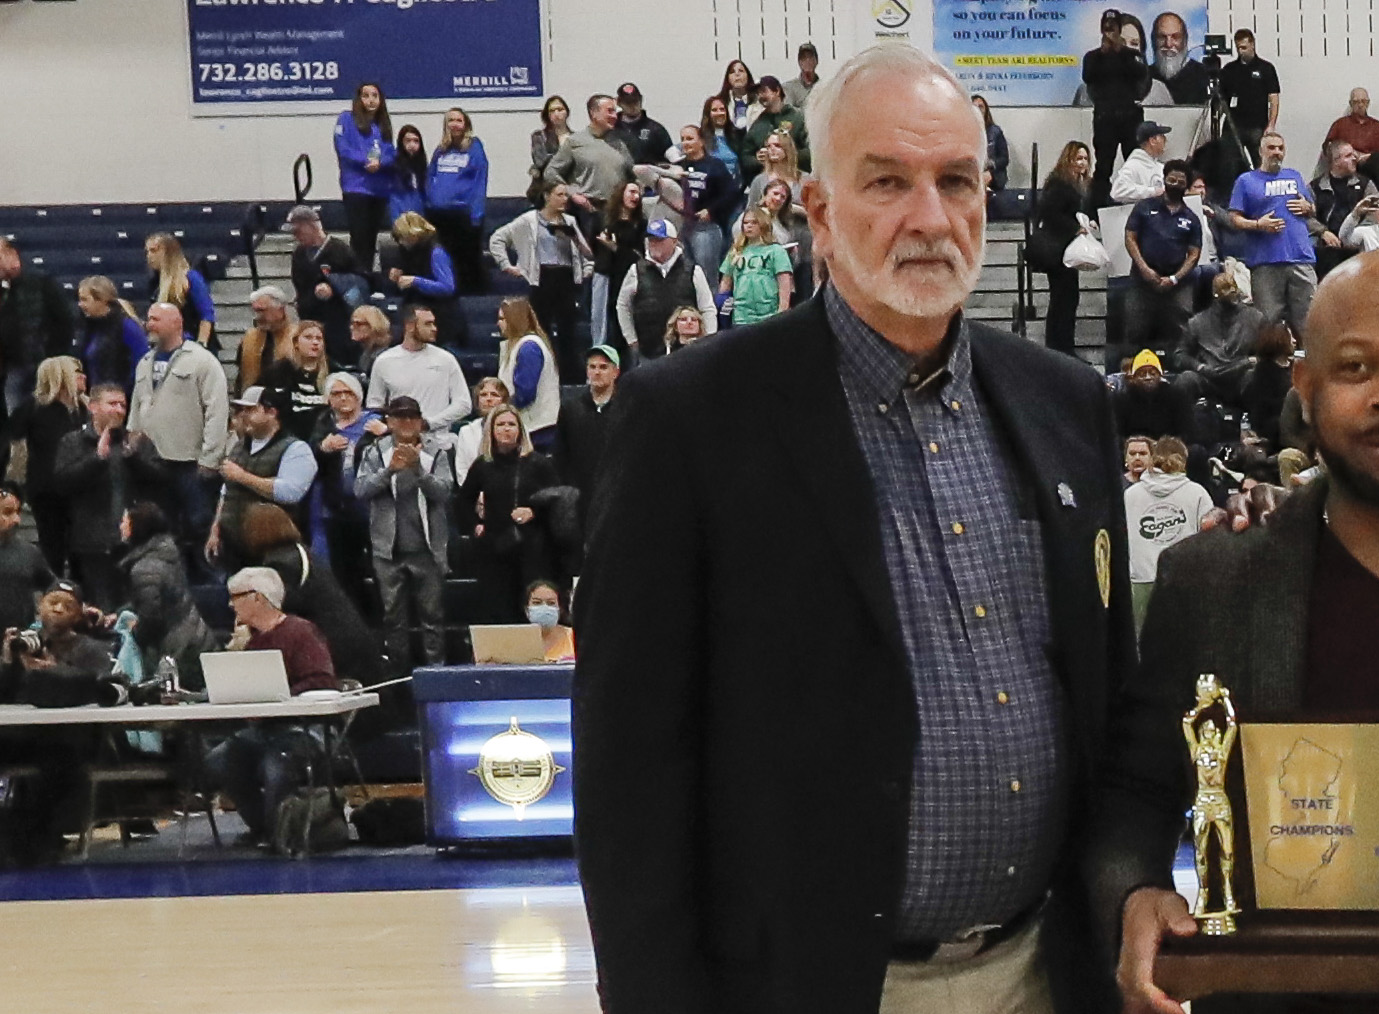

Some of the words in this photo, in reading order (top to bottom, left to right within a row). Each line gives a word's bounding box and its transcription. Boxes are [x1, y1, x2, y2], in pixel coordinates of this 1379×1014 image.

[952, 11, 968, 20] so
[971, 11, 997, 24] you
[999, 11, 1025, 20] can
[1028, 7, 1066, 20] focus
[952, 29, 972, 39] on
[973, 29, 1008, 43] your
[1010, 26, 1062, 40] future.
[198, 61, 339, 82] 732.286.3128
[453, 76, 508, 86] MERRILL
[1264, 180, 1298, 197] NIKE
[1291, 798, 1334, 810] STATE
[1269, 825, 1355, 836] CHAMPIONS
